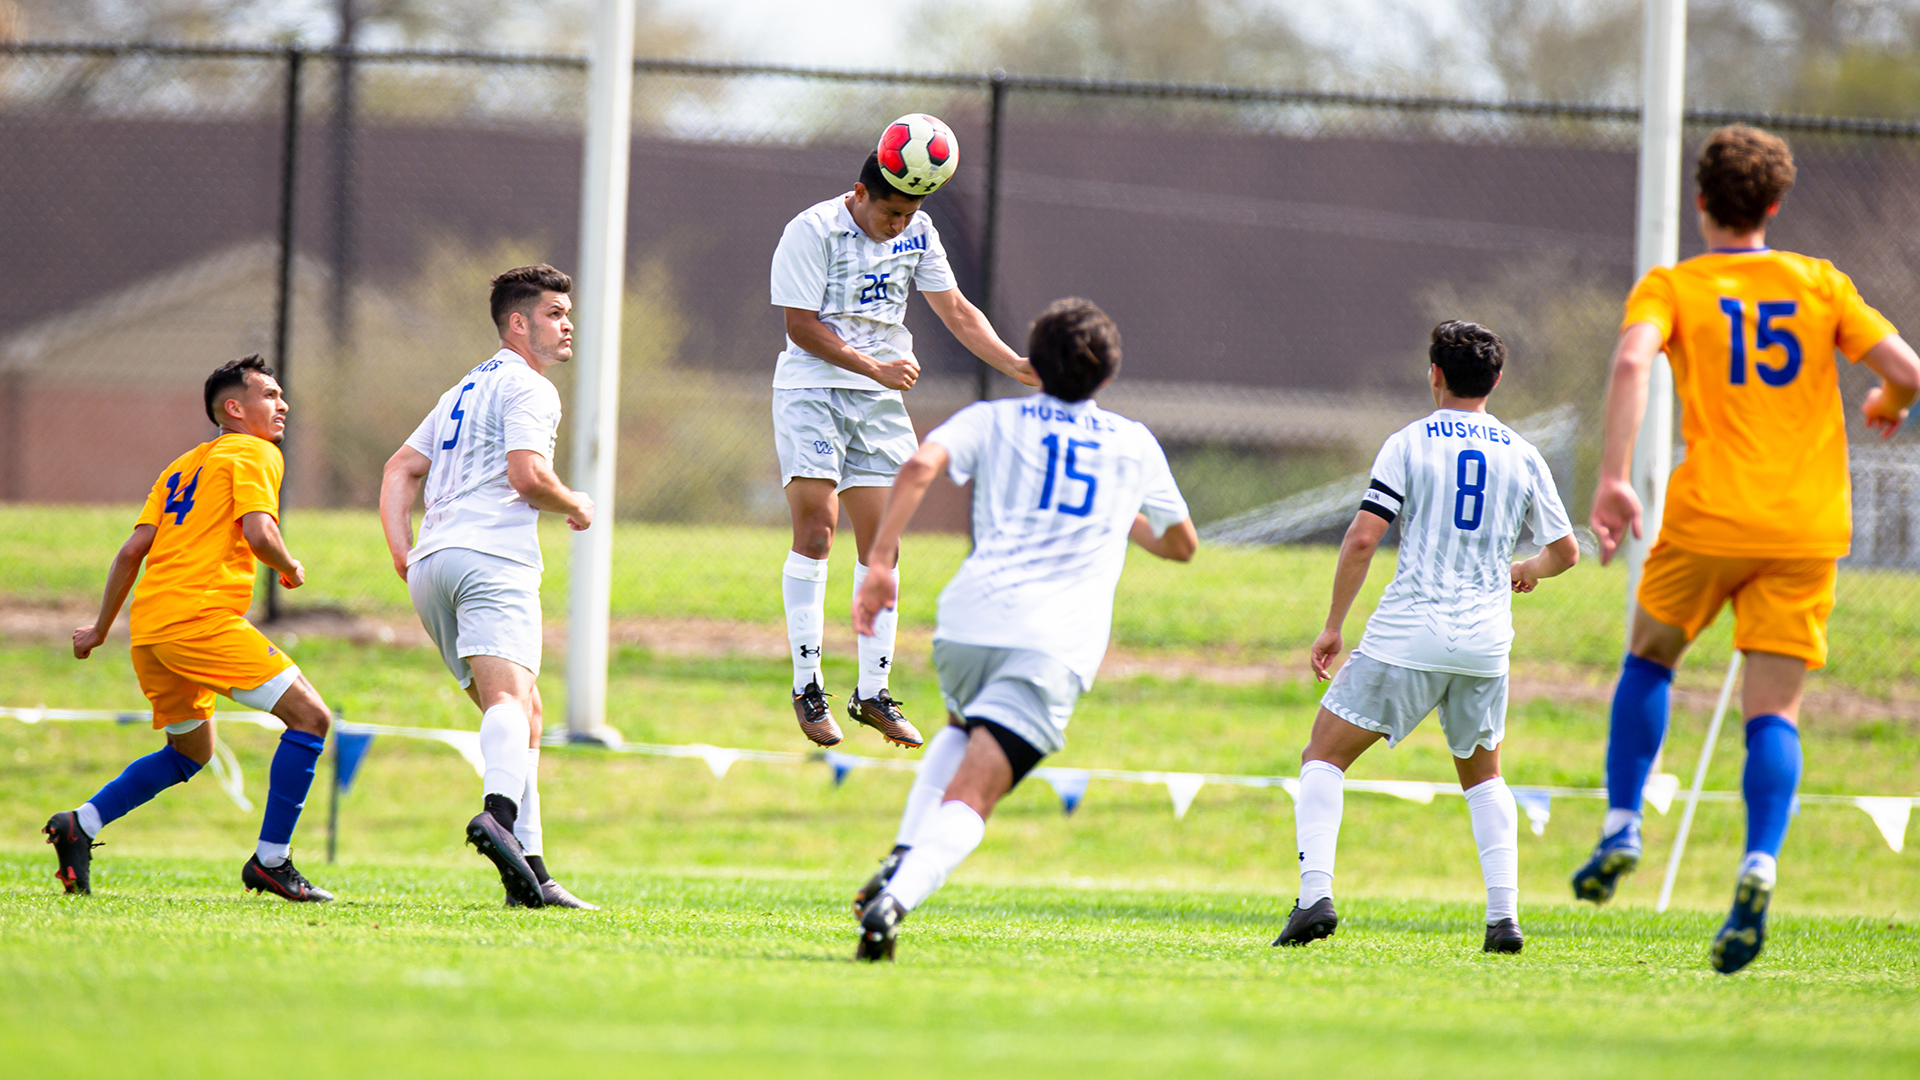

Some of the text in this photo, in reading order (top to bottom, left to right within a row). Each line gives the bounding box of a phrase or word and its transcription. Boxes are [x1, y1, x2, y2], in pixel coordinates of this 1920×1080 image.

[860, 273, 891, 305] 26
[1719, 296, 1804, 387] 15
[442, 382, 476, 450] 5
[1426, 421, 1511, 446] HUSKIES
[164, 466, 204, 525] 14
[1039, 432, 1102, 517] 15
[1454, 449, 1487, 531] 8
